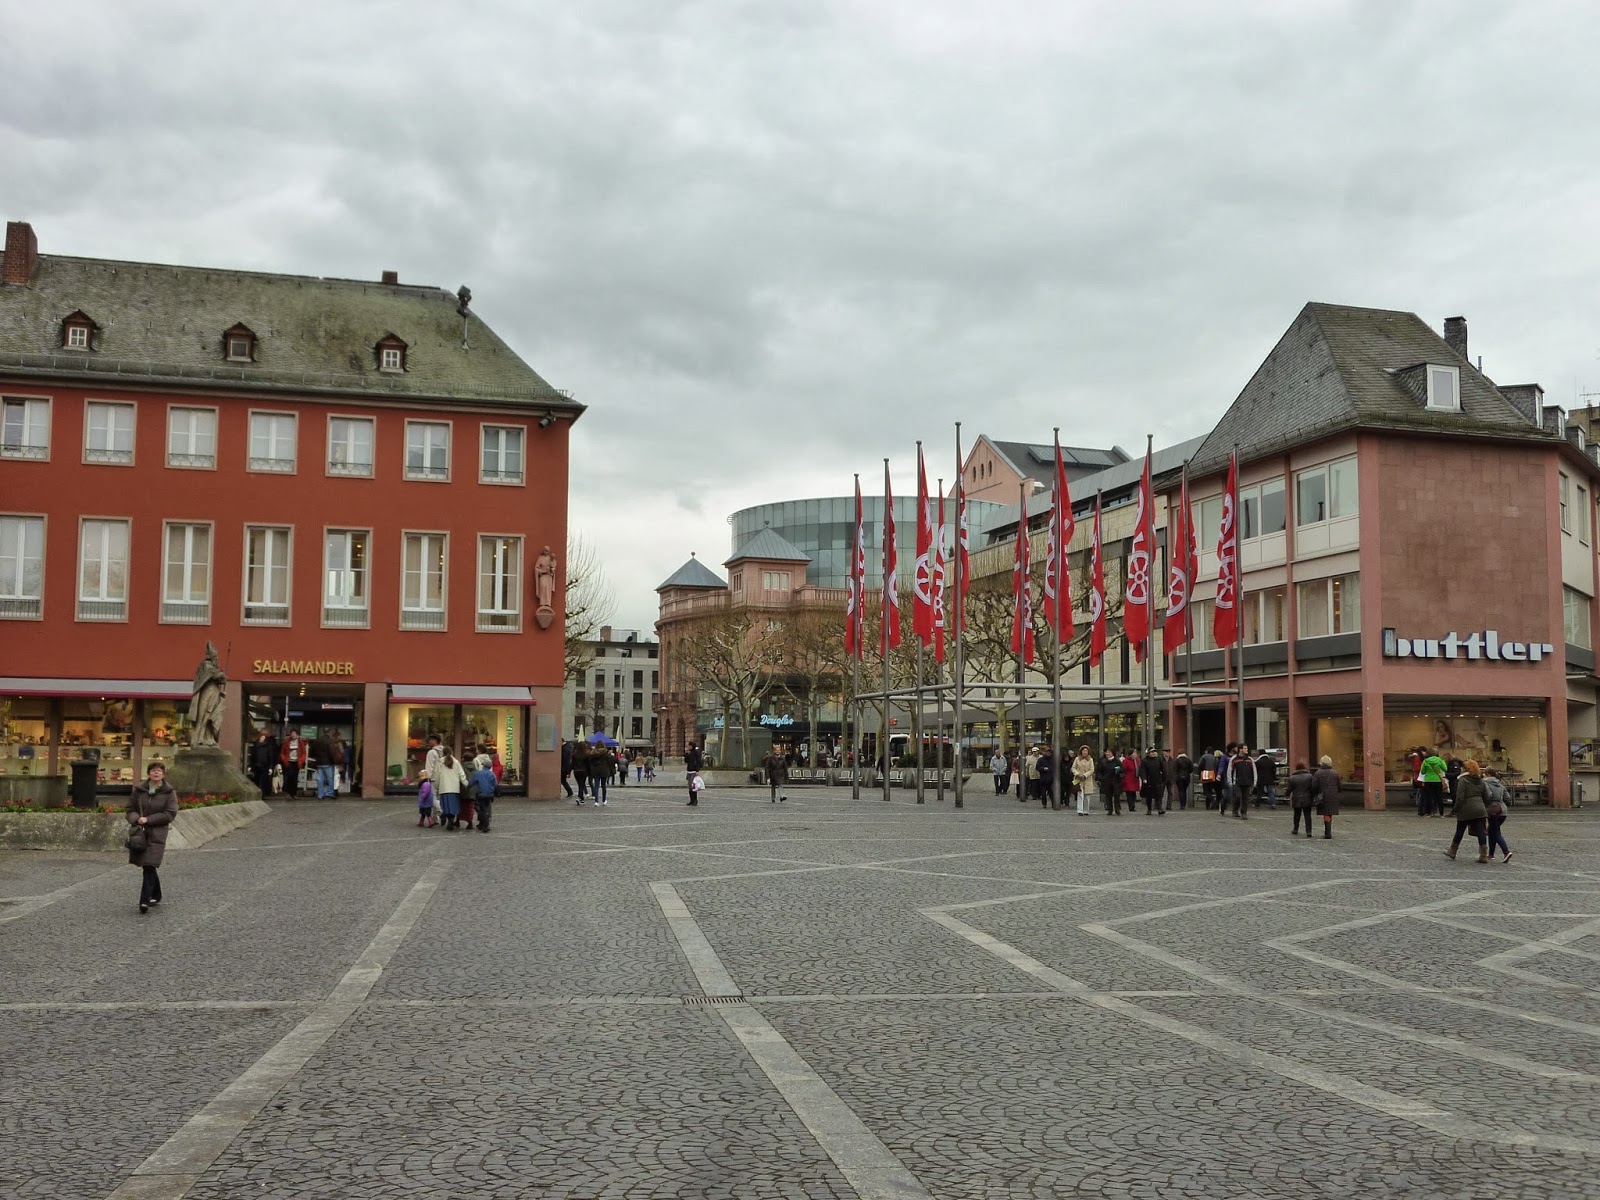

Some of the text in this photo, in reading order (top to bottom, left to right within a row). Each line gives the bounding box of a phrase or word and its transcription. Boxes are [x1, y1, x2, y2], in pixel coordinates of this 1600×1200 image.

[1383, 628, 1553, 661] buttler
[253, 660, 354, 675] SALAMANDER
[760, 714, 794, 728] Douglas
